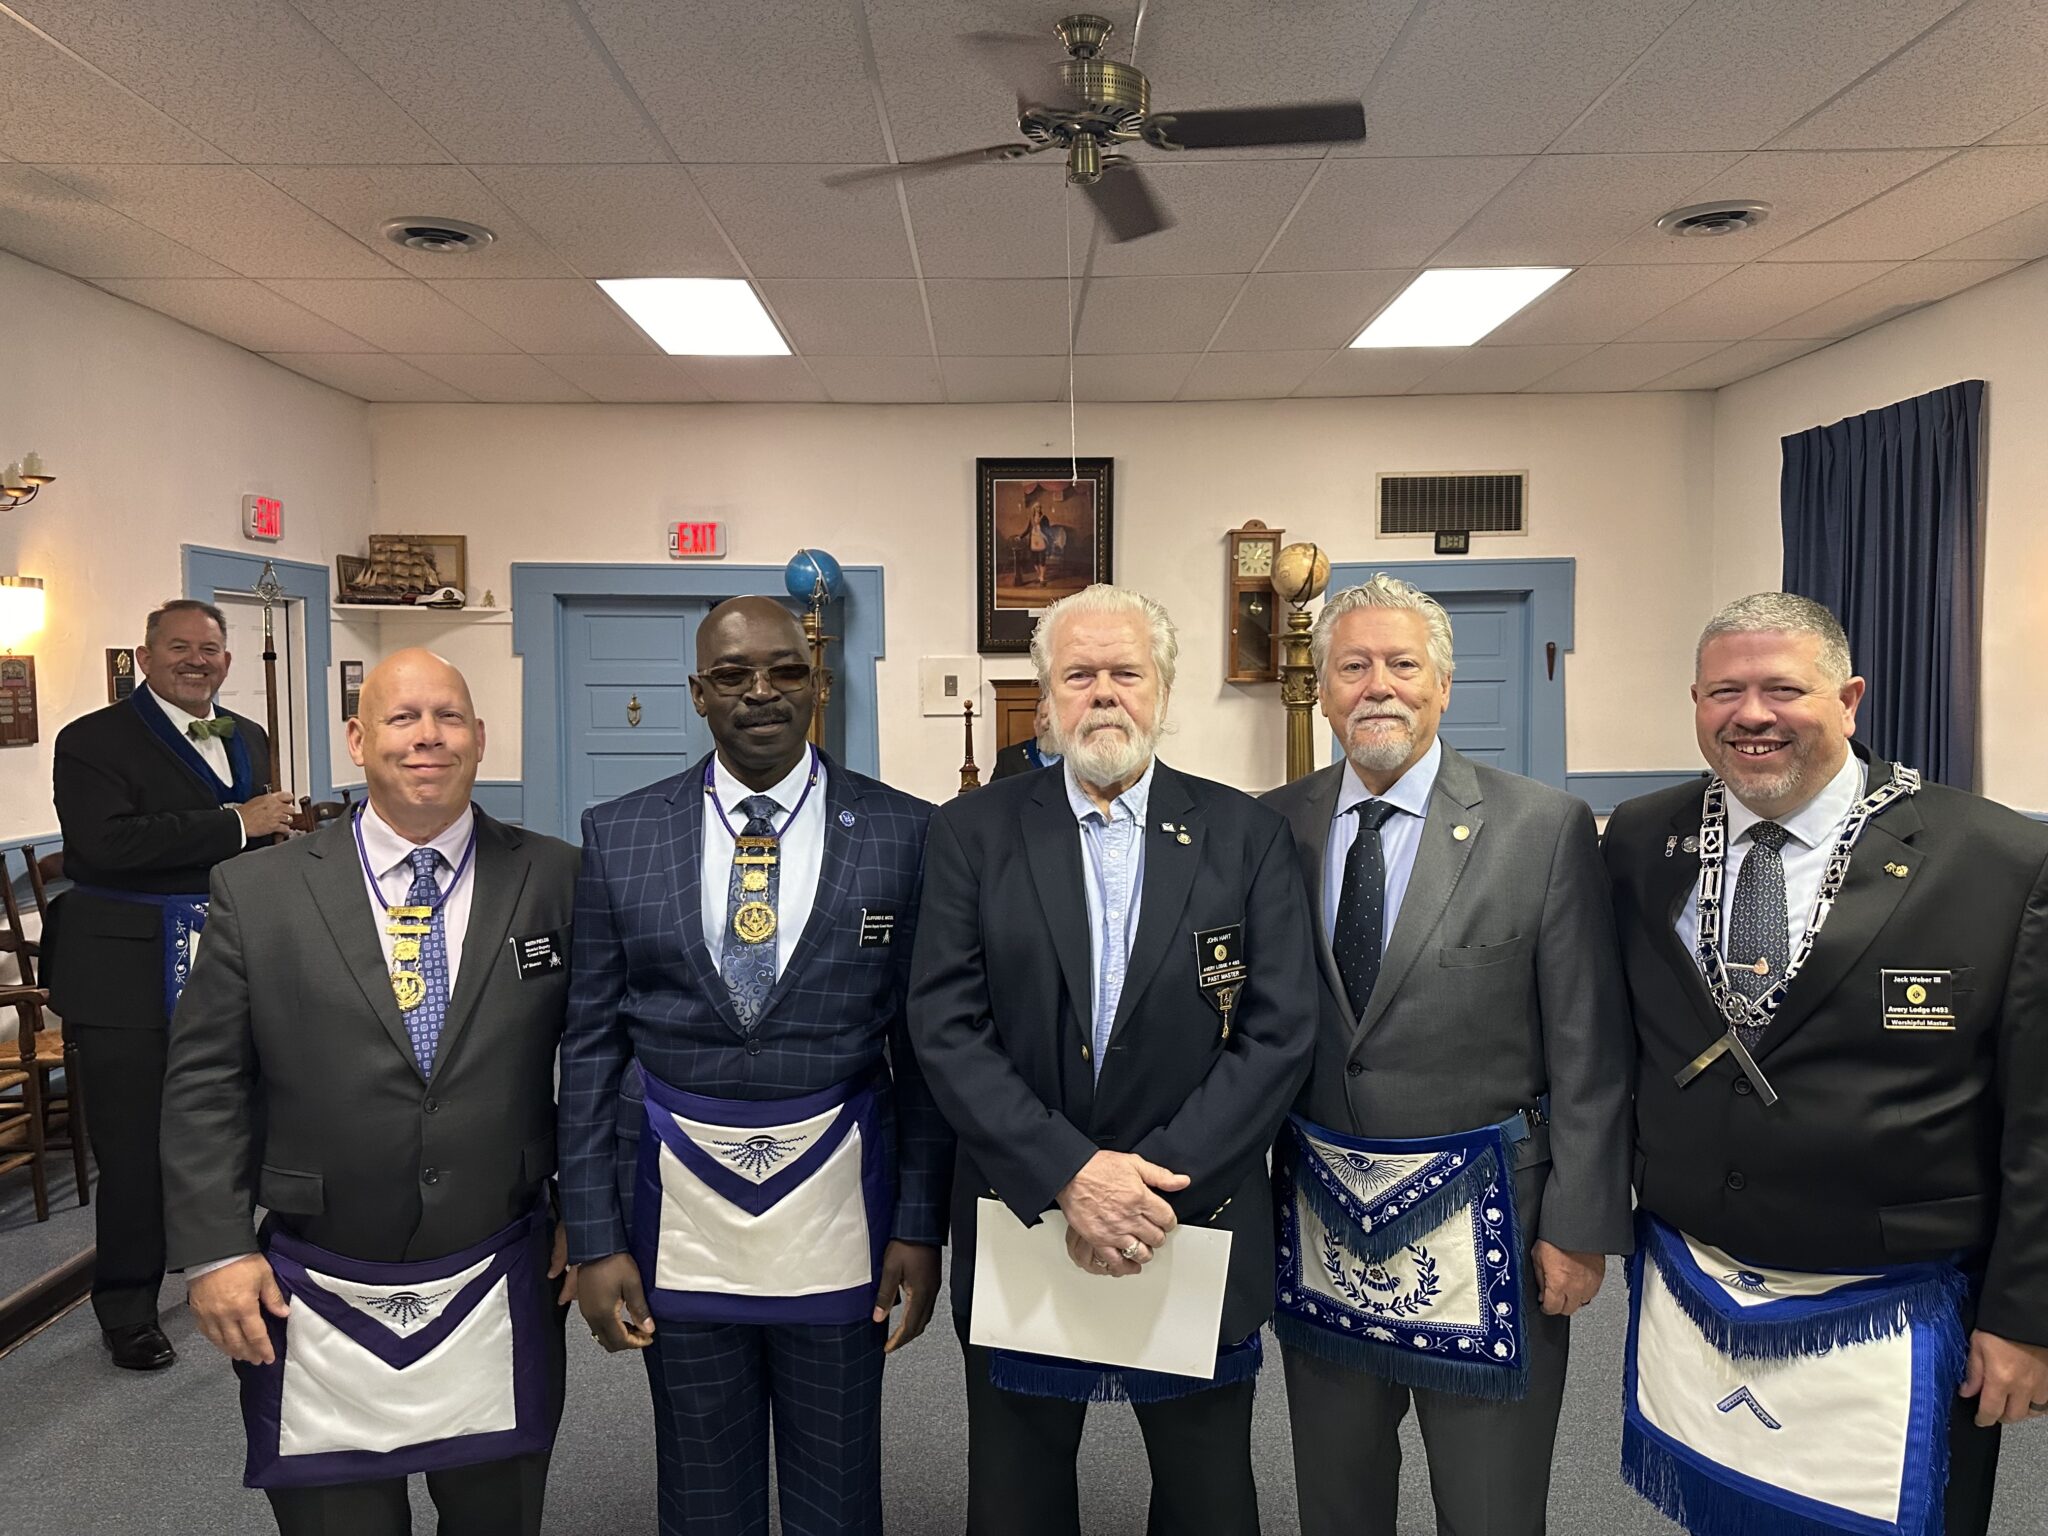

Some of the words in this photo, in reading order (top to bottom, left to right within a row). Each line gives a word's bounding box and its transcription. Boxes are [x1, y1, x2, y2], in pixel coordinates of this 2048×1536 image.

[256, 496, 281, 537] EXIT
[678, 522, 717, 555] EXIT
[1206, 936, 1218, 944] JOHN
[1207, 975, 1220, 983] PAST
[1221, 970, 1239, 979] MASTER
[1888, 1006, 1908, 1014] Avery
[1909, 1006, 1930, 1014] Lodge
